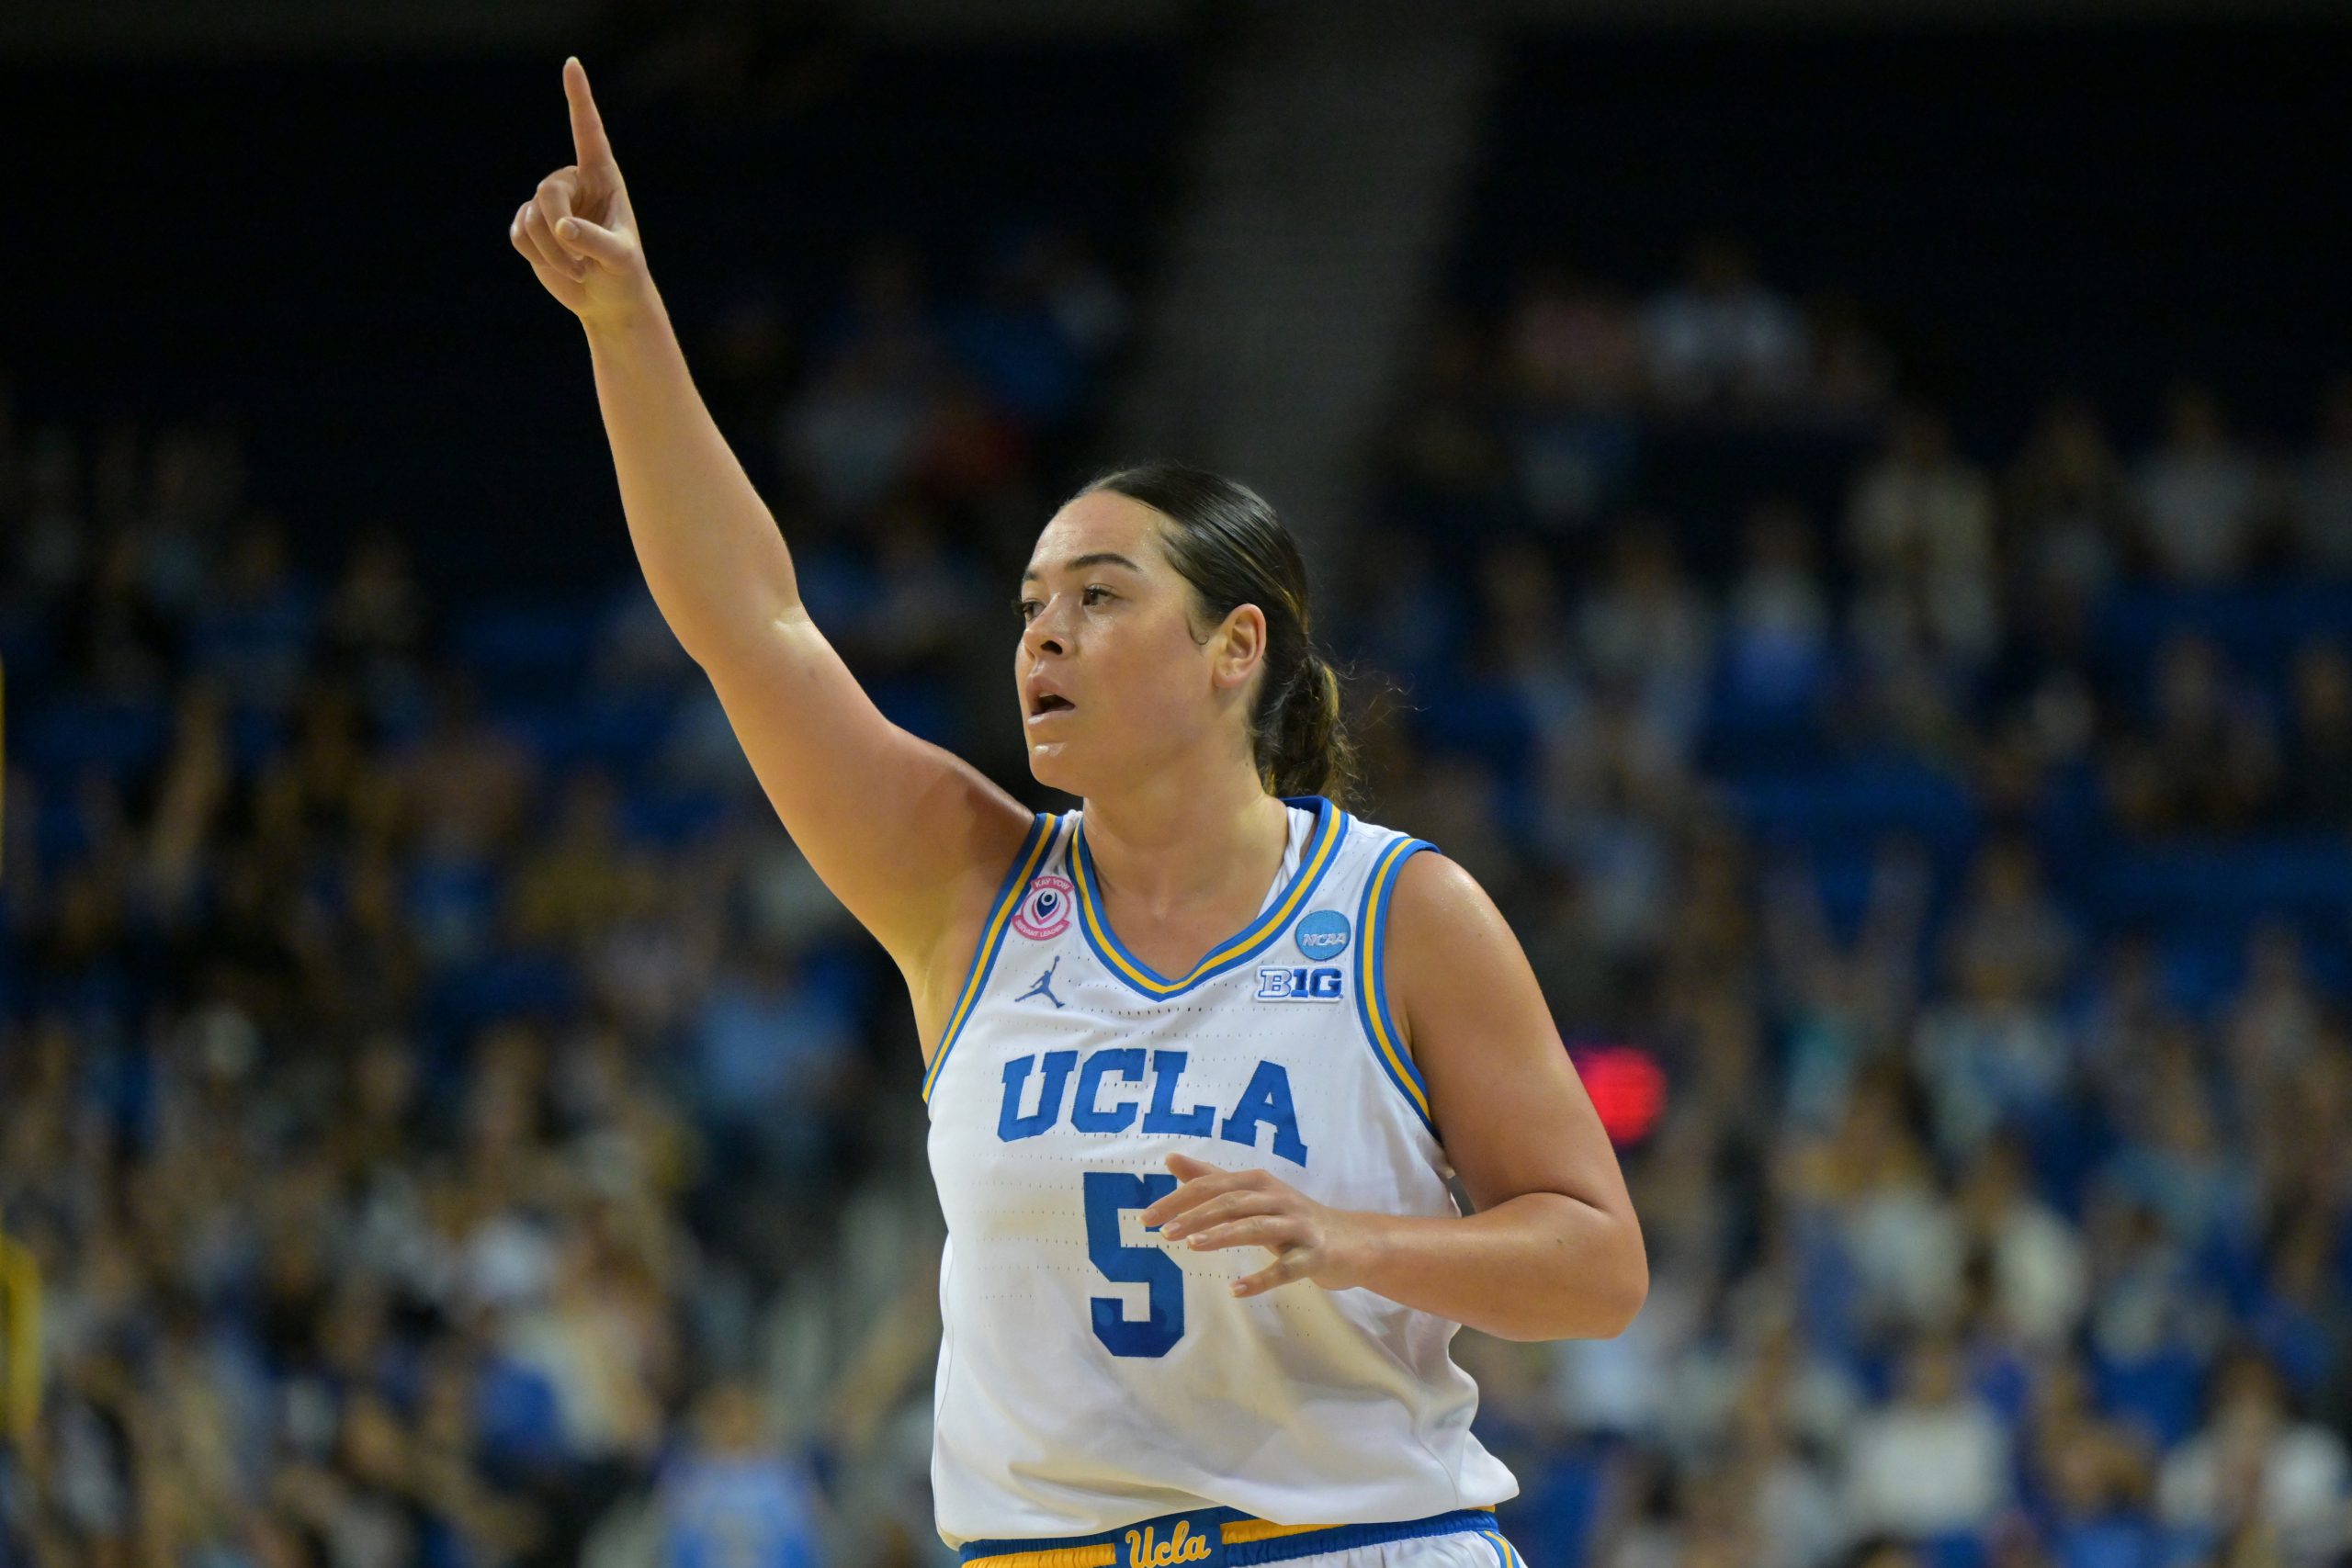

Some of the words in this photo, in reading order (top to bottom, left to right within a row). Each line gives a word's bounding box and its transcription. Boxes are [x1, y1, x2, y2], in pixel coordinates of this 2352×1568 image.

[1035, 878, 1051, 888] KAY
[1053, 878, 1070, 890] YOW
[1302, 932, 1347, 946] NCAA
[998, 1048, 1307, 1167] UCLA
[1083, 1171, 1185, 1358] 5
[1125, 1520, 1212, 1568] Ucla
